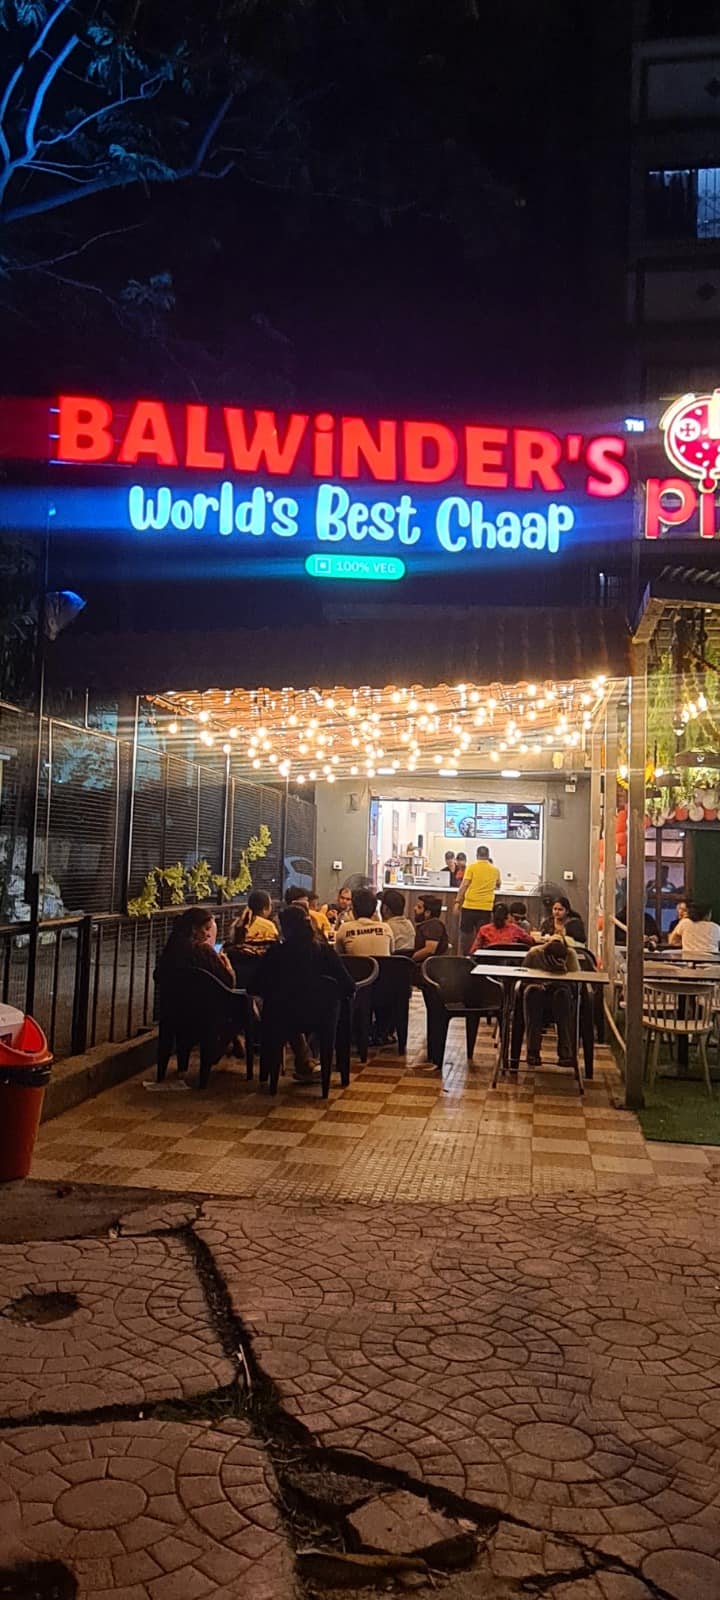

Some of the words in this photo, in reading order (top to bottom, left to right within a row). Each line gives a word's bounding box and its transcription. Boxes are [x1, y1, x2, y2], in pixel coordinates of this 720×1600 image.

[625, 418, 645, 432] TM
[129, 481, 299, 537] World's
[315, 484, 422, 545] Best
[436, 496, 575, 553] Chaap
[336, 561, 370, 573] 100%
[372, 562, 396, 574] VEG
